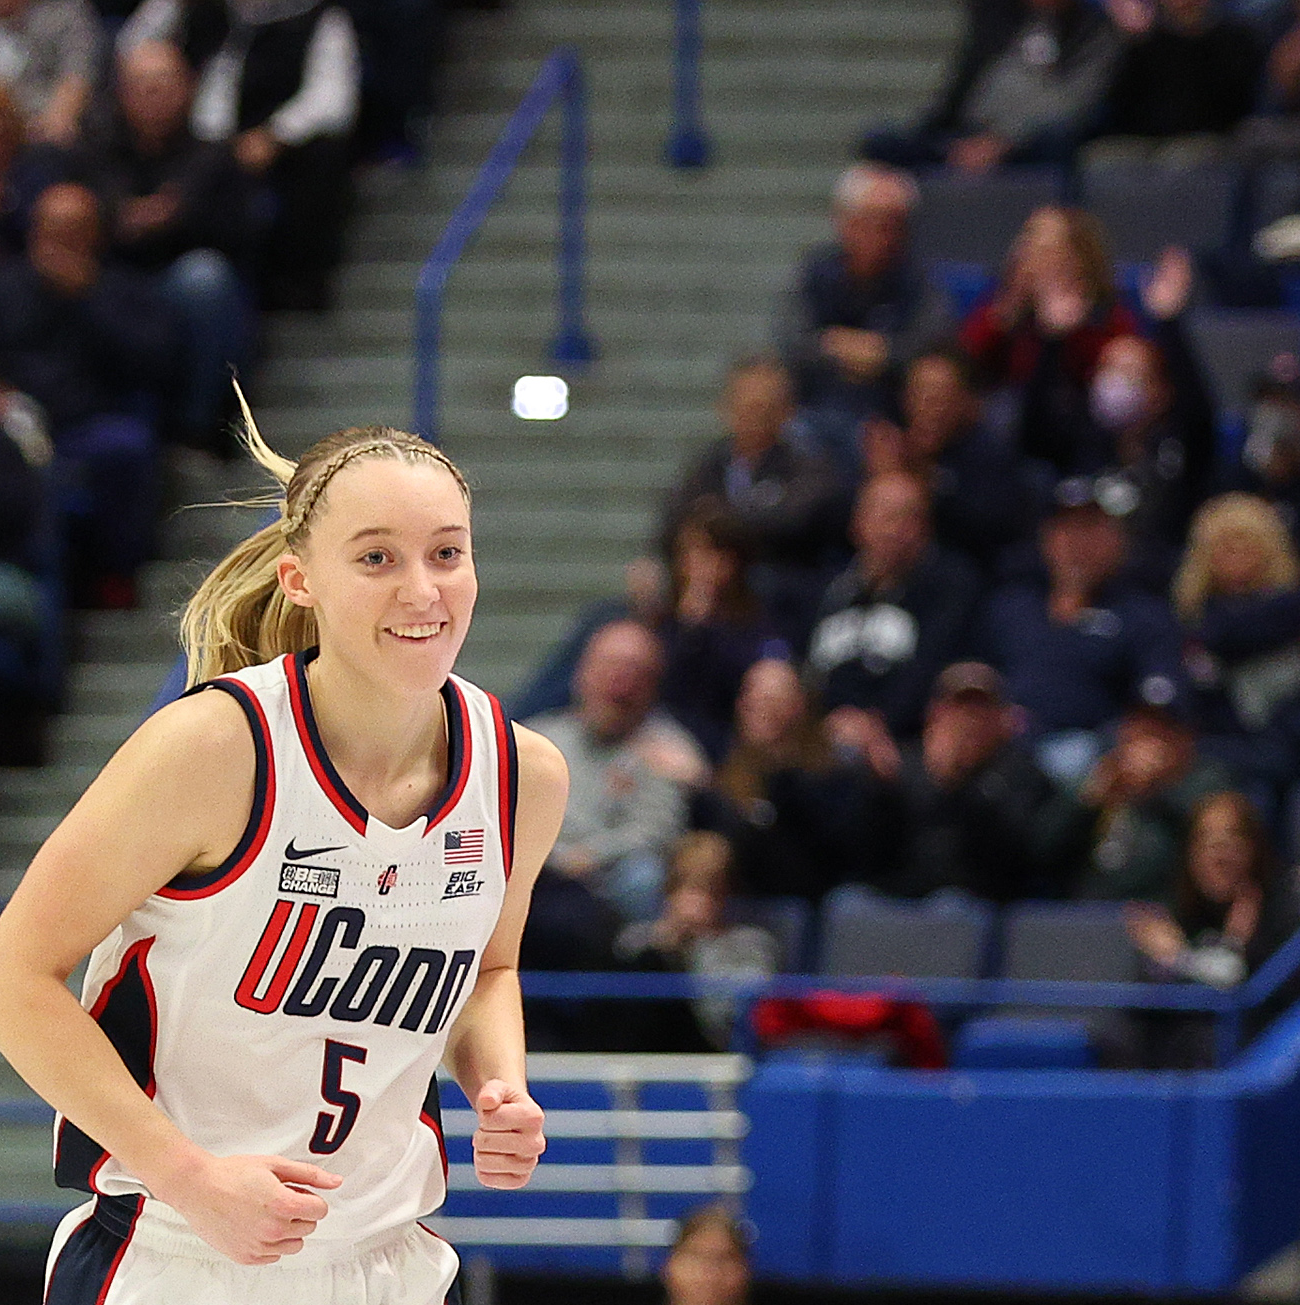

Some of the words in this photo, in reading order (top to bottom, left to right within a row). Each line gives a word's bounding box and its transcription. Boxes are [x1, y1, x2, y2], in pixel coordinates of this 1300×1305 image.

[449, 870, 477, 882] BIG
[281, 879, 337, 895] CHANGE
[444, 881, 485, 894] EAST
[234, 899, 476, 1035] UConn
[308, 1038, 368, 1155] 5
